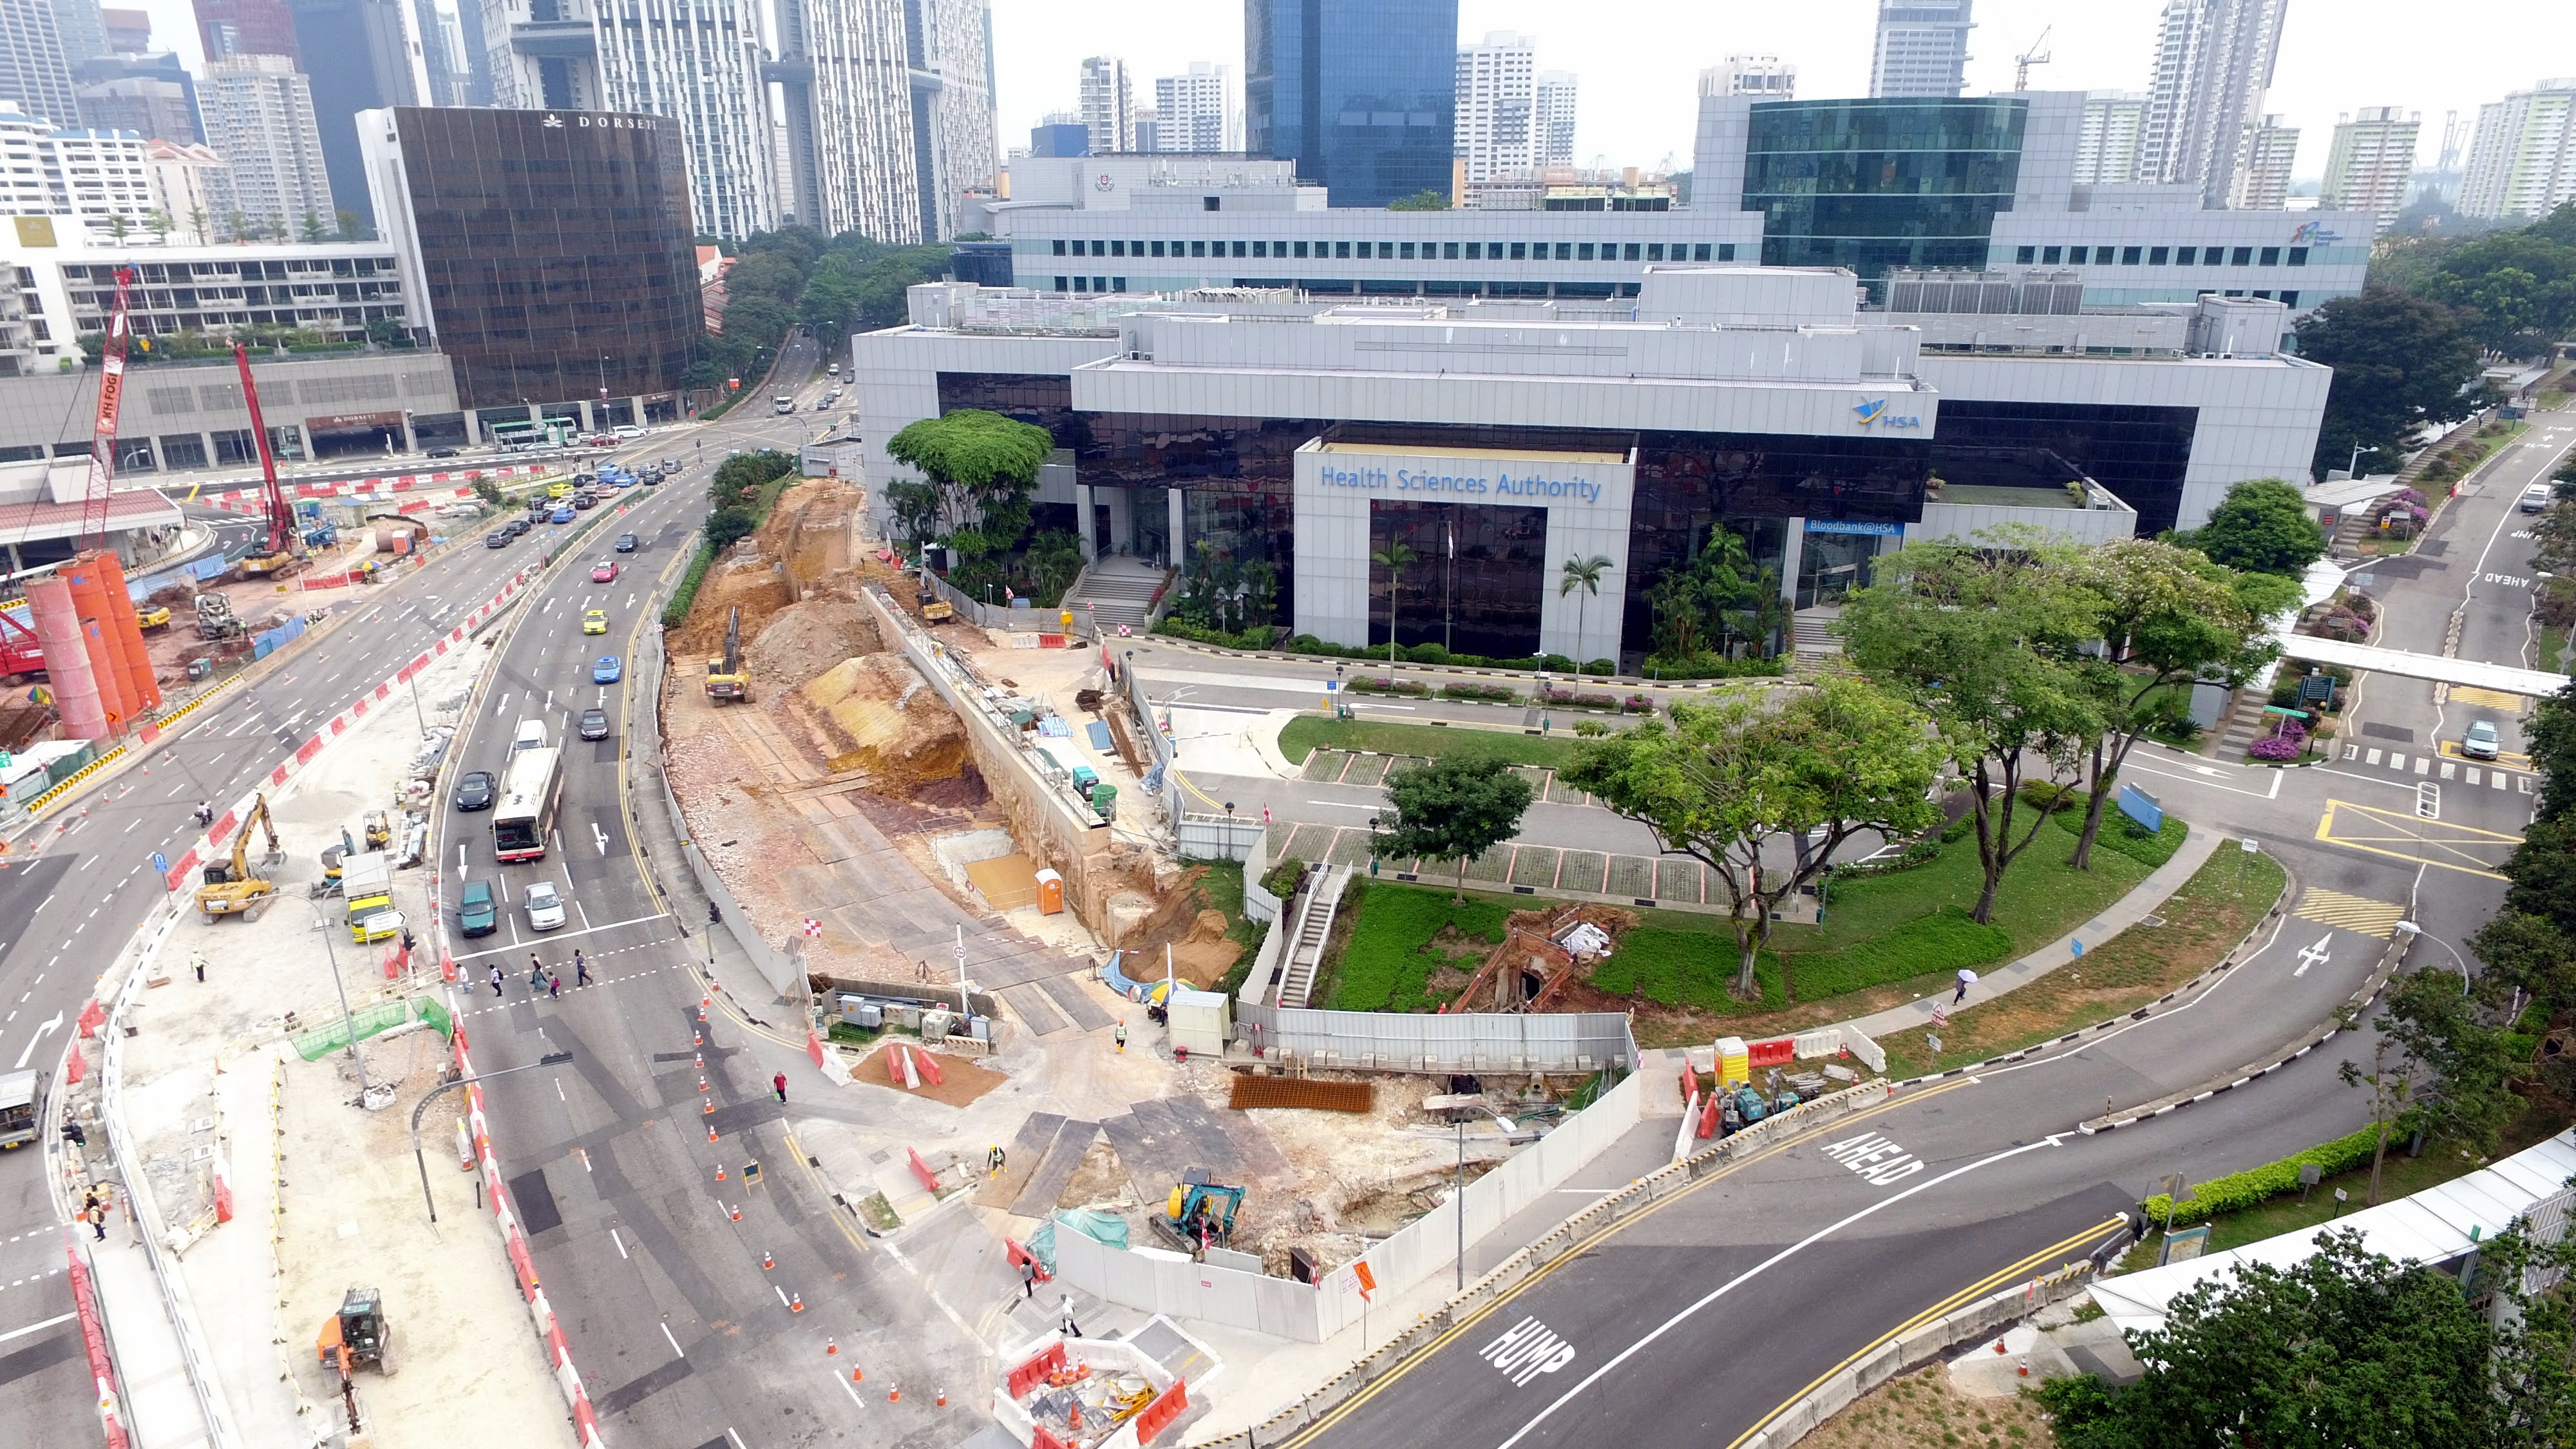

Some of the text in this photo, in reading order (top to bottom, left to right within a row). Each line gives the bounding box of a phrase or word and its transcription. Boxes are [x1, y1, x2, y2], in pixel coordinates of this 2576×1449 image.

[579, 117, 656, 130] DORSETT
[102, 402, 113, 419] KH
[1883, 415, 1920, 428] HSA
[1321, 466, 1601, 503] Health Sciences Authority
[1810, 520, 1895, 535] Bloodbank@HSA
[2485, 573, 2530, 587] AHEAD
[1821, 1131, 1924, 1186] AHEAD
[1479, 1315, 1575, 1387] HUMP
